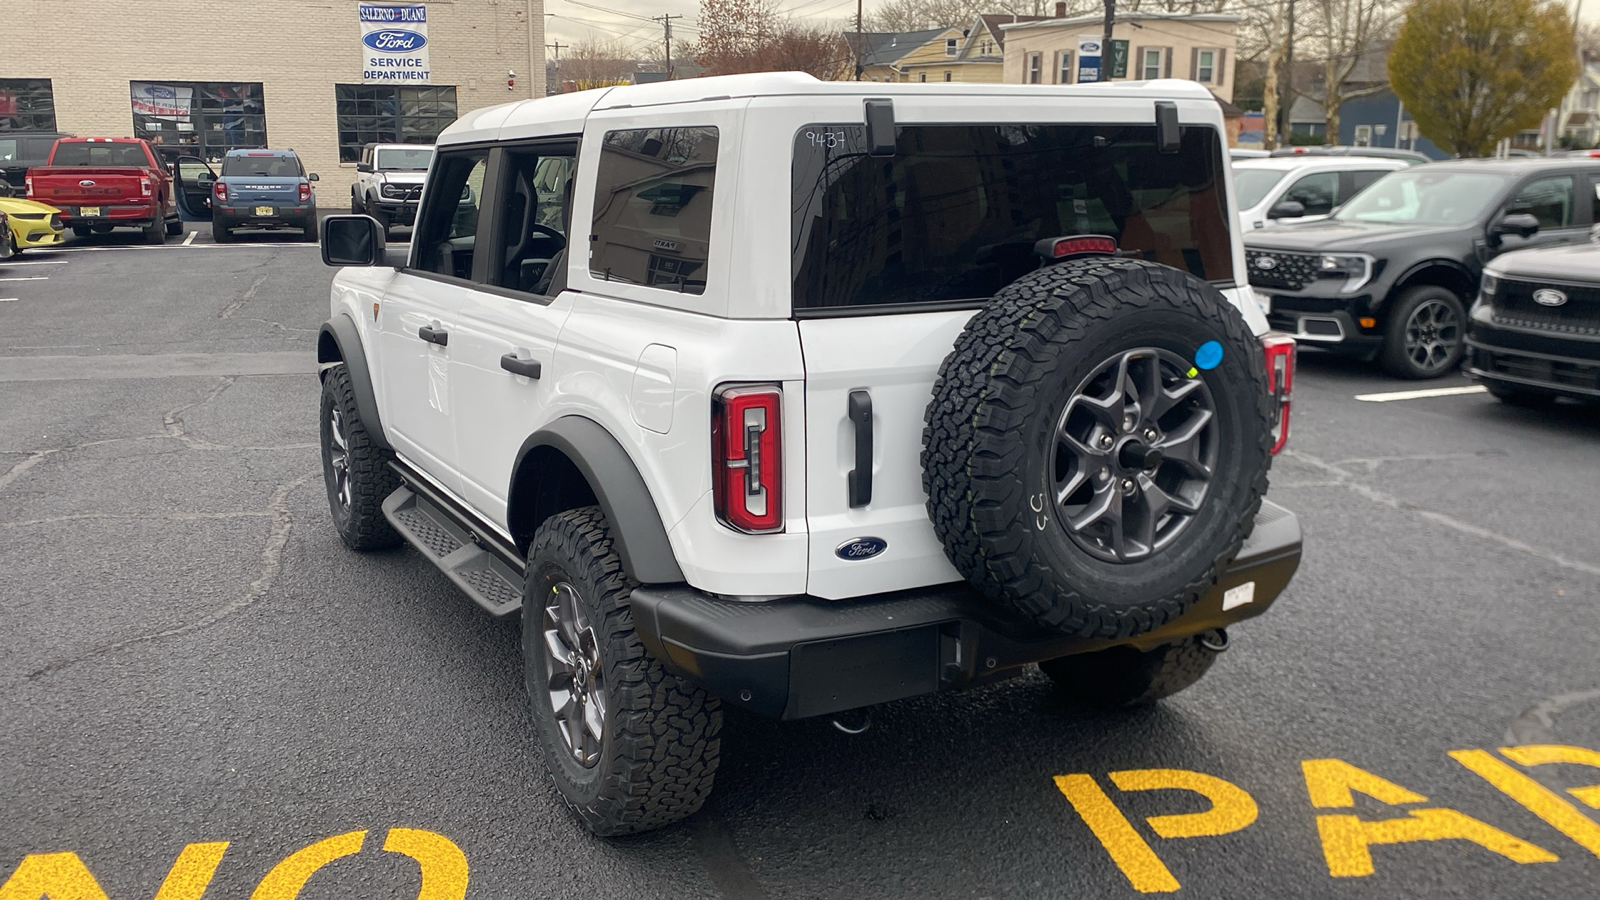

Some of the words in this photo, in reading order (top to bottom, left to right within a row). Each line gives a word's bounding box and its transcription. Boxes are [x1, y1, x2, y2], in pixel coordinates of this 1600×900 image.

[360, 7, 395, 21] SALERNO
[401, 7, 426, 21] DUANE
[375, 32, 415, 49] Ford
[370, 58, 423, 67] SERVICE
[363, 70, 430, 80] DEPARTMENT
[805, 131, 846, 149] 9437
[847, 541, 877, 557] Ford
